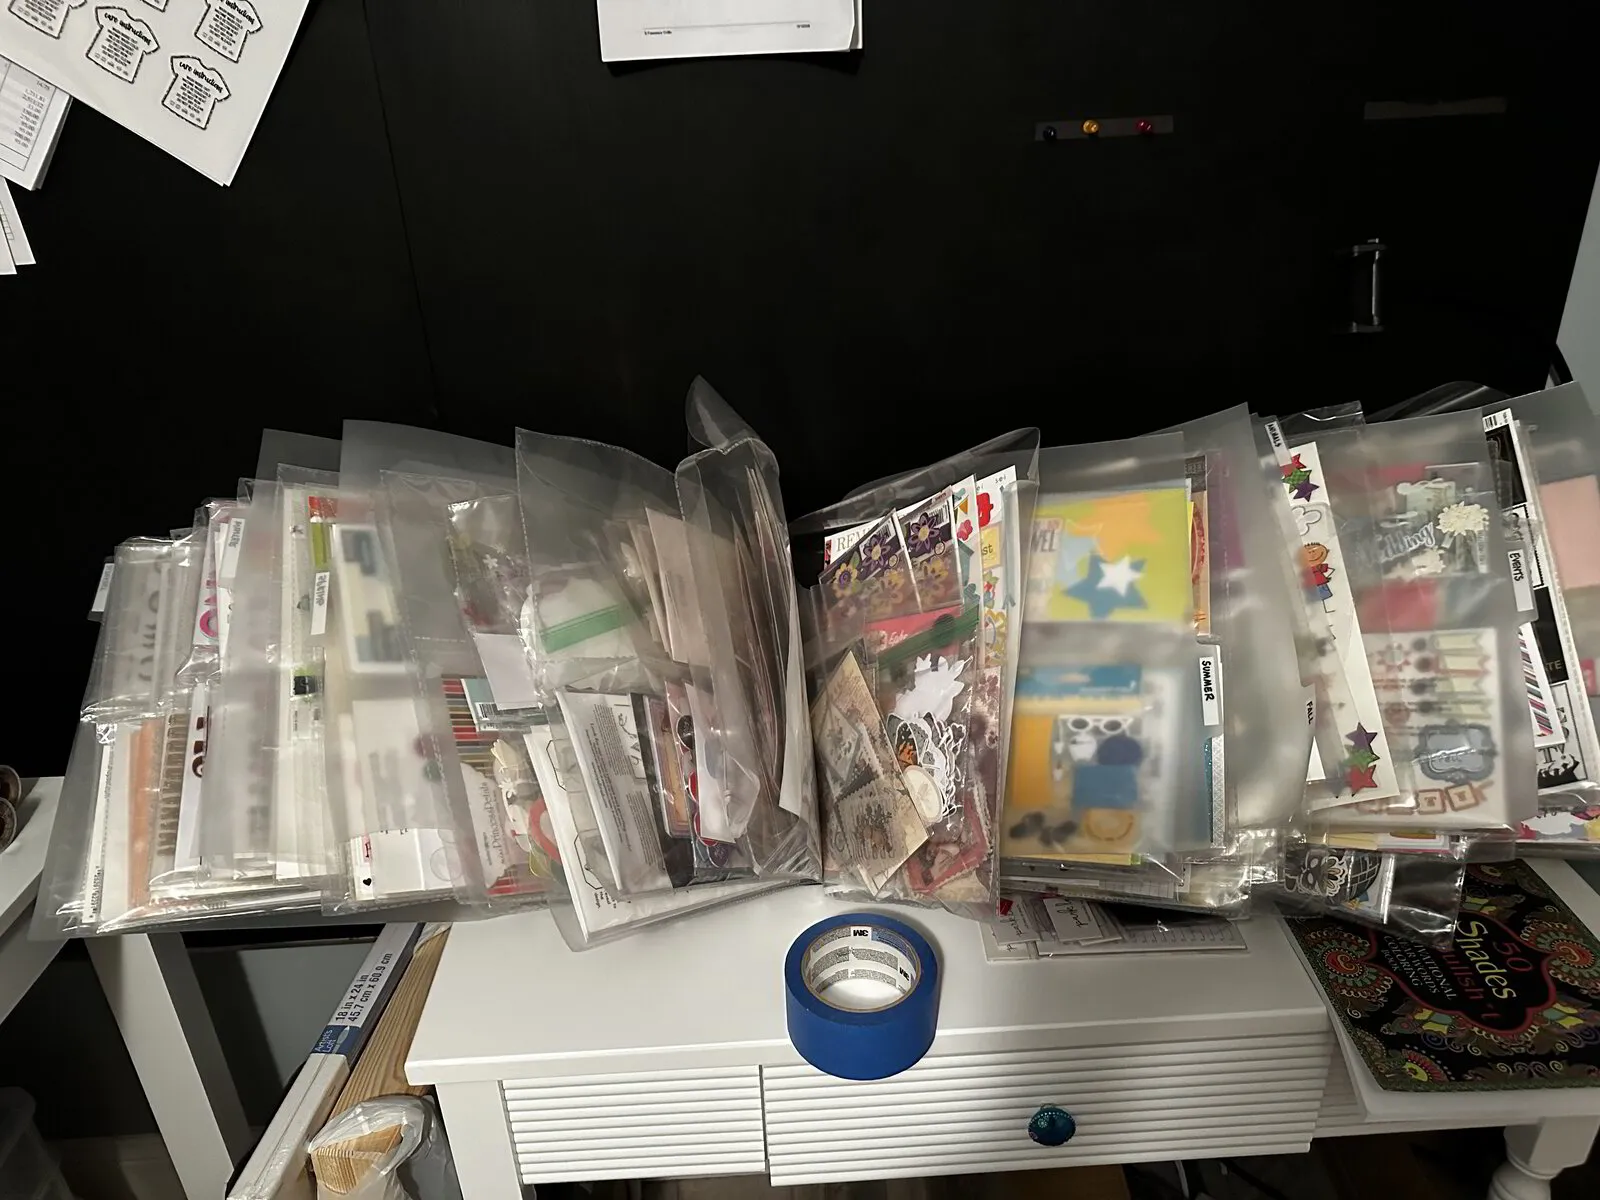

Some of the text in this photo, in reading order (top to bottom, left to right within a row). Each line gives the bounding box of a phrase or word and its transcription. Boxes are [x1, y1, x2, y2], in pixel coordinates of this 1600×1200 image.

[104, 12, 118, 23] care
[119, 20, 152, 46] instructions
[179, 61, 193, 73] care
[193, 68, 223, 94] instructions
[1267, 421, 1282, 448] ANIMALS
[981, 544, 994, 556] st
[1509, 552, 1525, 582] EVENTS
[1544, 660, 1562, 672] TE
[1201, 660, 1215, 702] SUMMER
[1306, 700, 1314, 725] FALL
[853, 929, 869, 937] 3M
[1381, 949, 1402, 972] BOOK
[1383, 935, 1424, 987] COLORING
[1410, 941, 1457, 1000] IVATIONAL
[1456, 920, 1517, 999] Shades
[1493, 941, 1533, 972] 50
[348, 1004, 364, 1022] 45.7
[360, 990, 372, 1002] cm
[369, 966, 386, 982] 60.9
[381, 953, 393, 964] cm
[899, 967, 910, 981] 3M
[1414, 958, 1441, 994] WORDS
[351, 984, 363, 993] 24
[335, 1012, 348, 1021] 18
[341, 1002, 354, 1010] in
